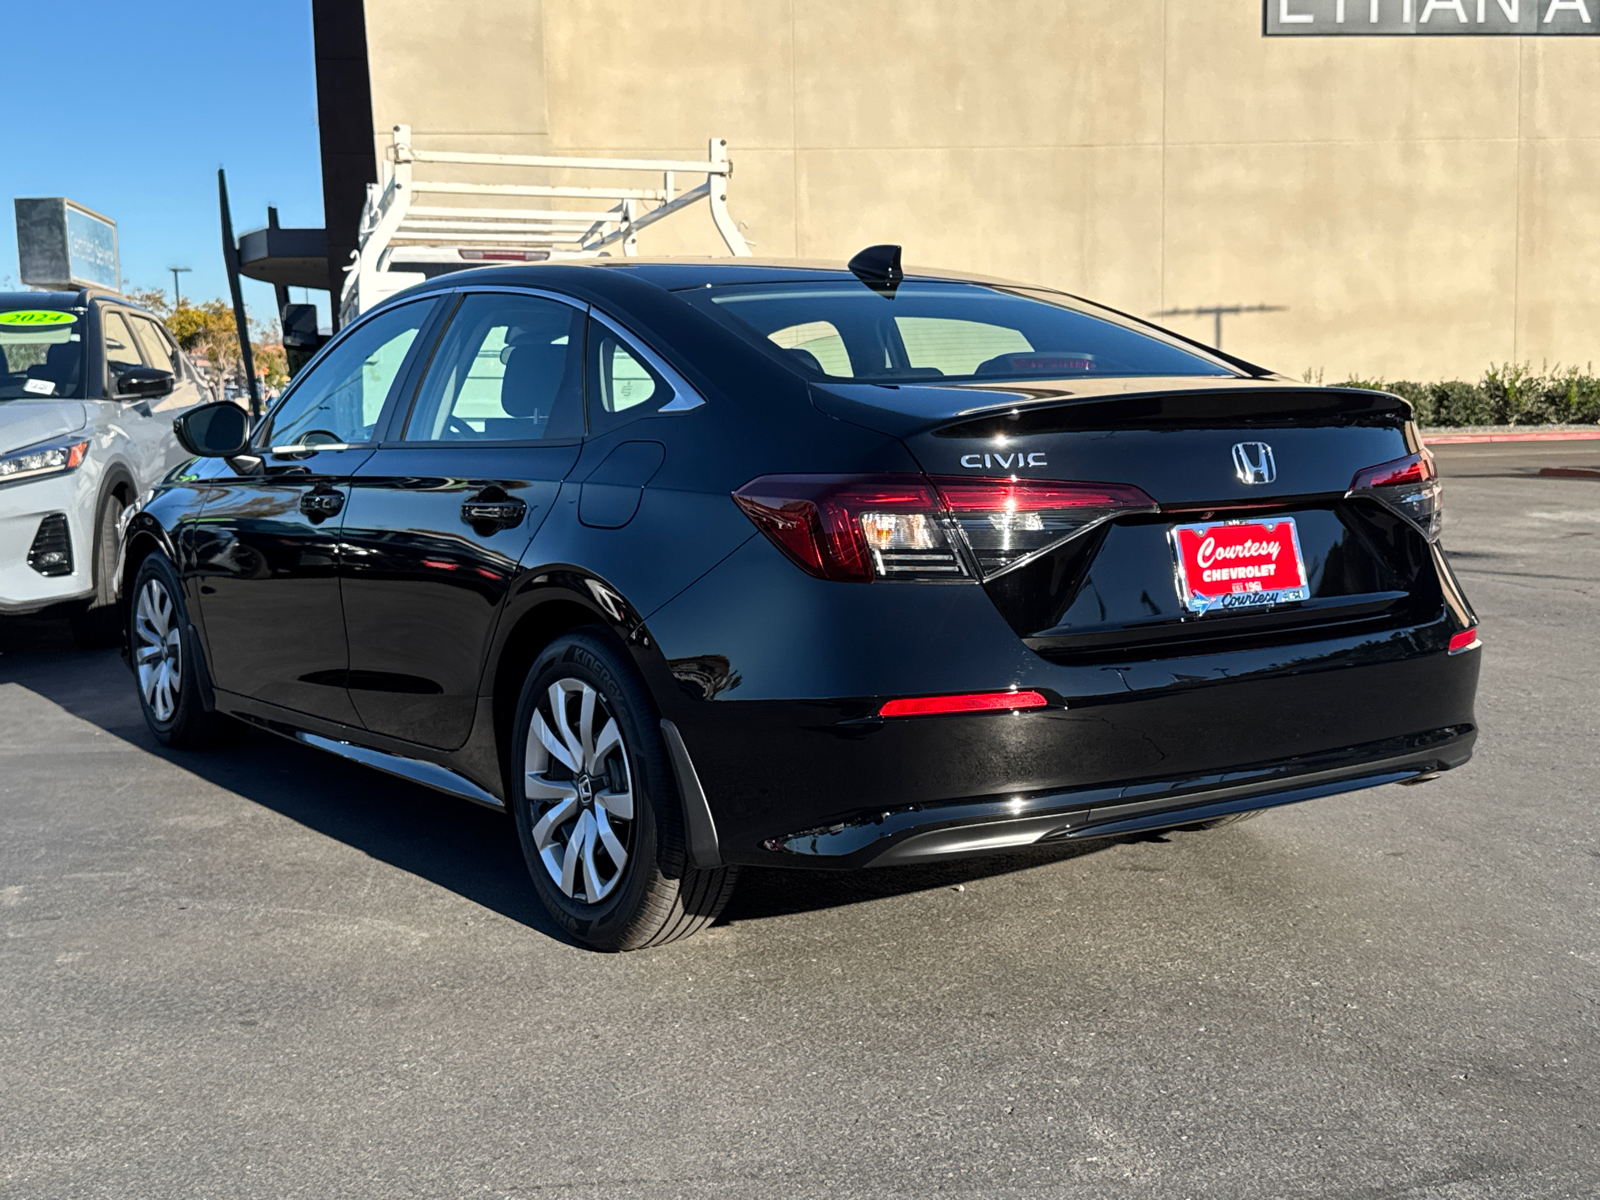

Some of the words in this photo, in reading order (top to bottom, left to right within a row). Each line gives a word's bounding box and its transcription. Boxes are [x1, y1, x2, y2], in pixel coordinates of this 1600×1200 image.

[7, 314, 64, 323] 2024
[960, 452, 1048, 469] CIVIC
[1197, 537, 1281, 568] Courtesy
[1202, 564, 1276, 582] CHEVROLET
[1221, 591, 1279, 607] Courtesy
[573, 646, 625, 701] KINERGY
